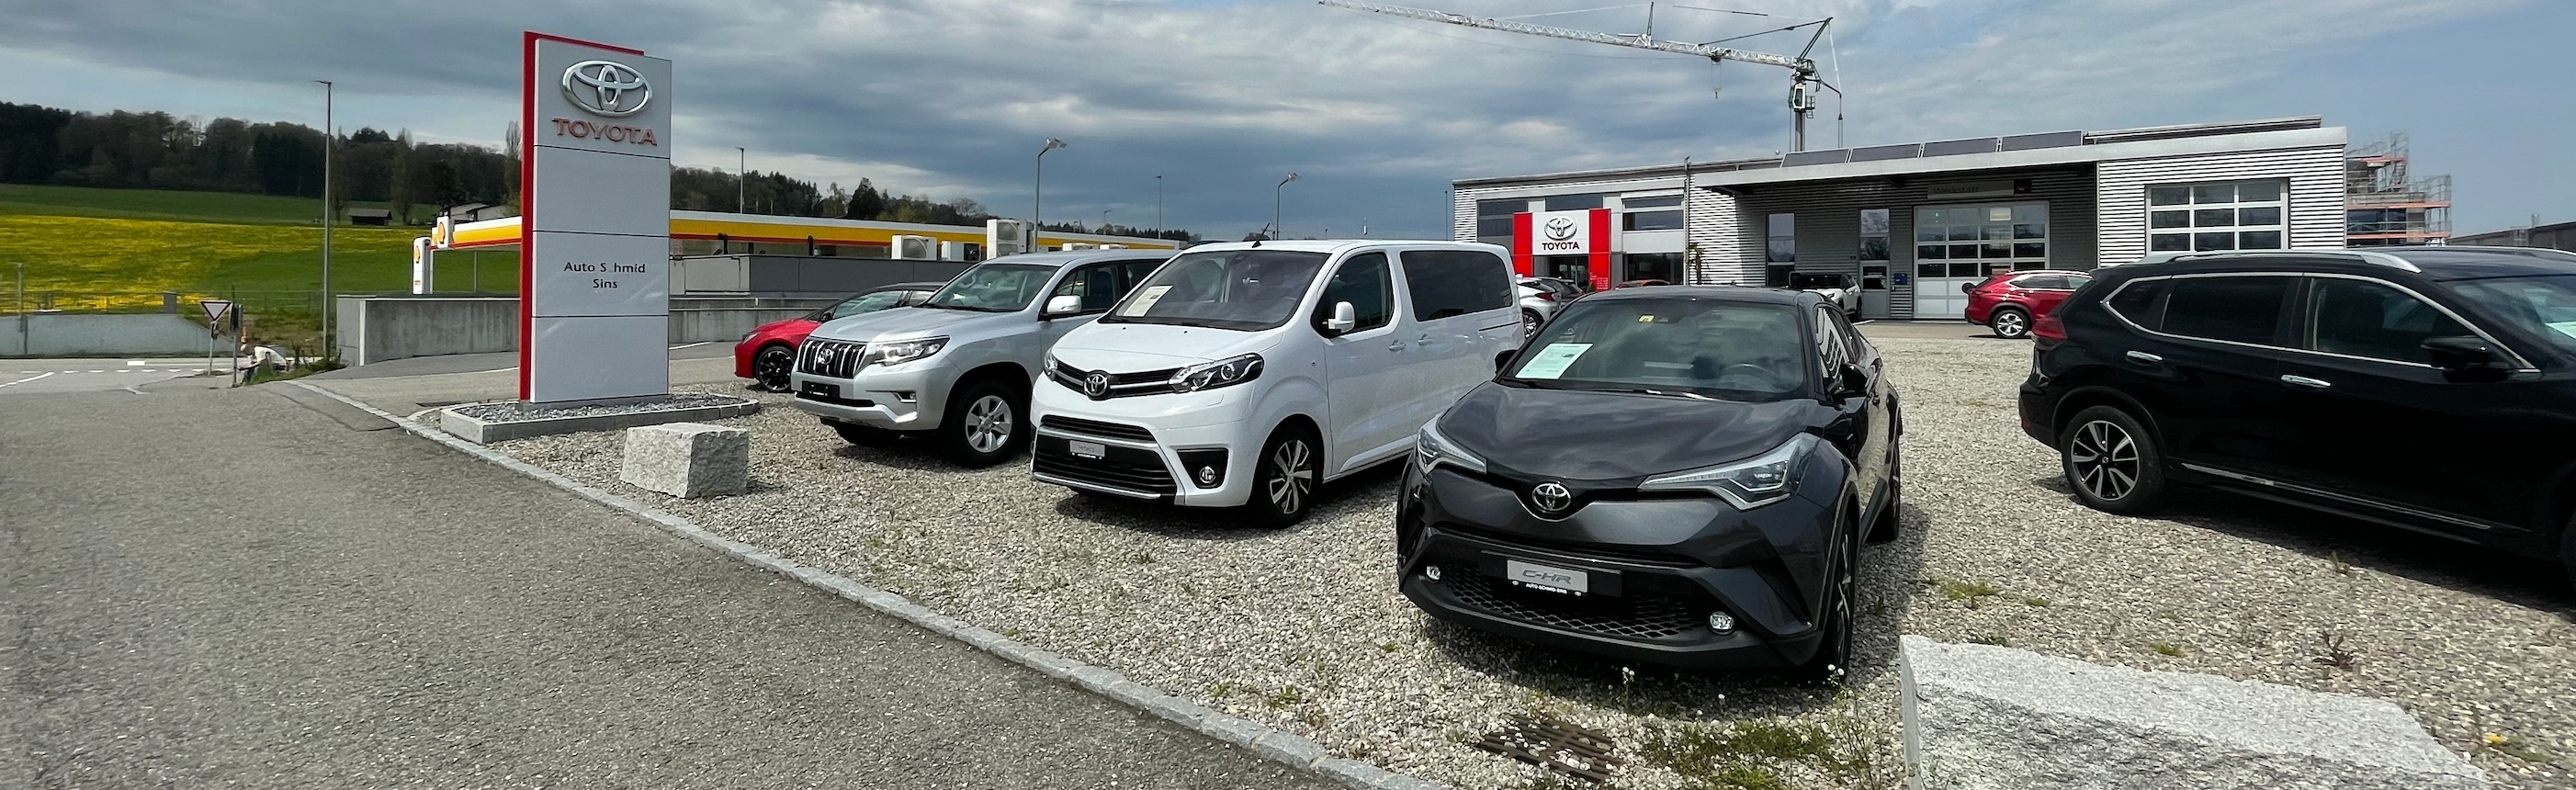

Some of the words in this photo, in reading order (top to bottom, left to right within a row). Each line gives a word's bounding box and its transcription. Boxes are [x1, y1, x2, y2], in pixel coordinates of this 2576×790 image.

[551, 117, 658, 147] TOYOTA
[1542, 242, 1580, 251] TOYOTA
[563, 262, 595, 272] Auto
[600, 262, 646, 273] Shmid
[593, 278, 618, 289] Sins
[1522, 570, 1572, 584] C-HR
